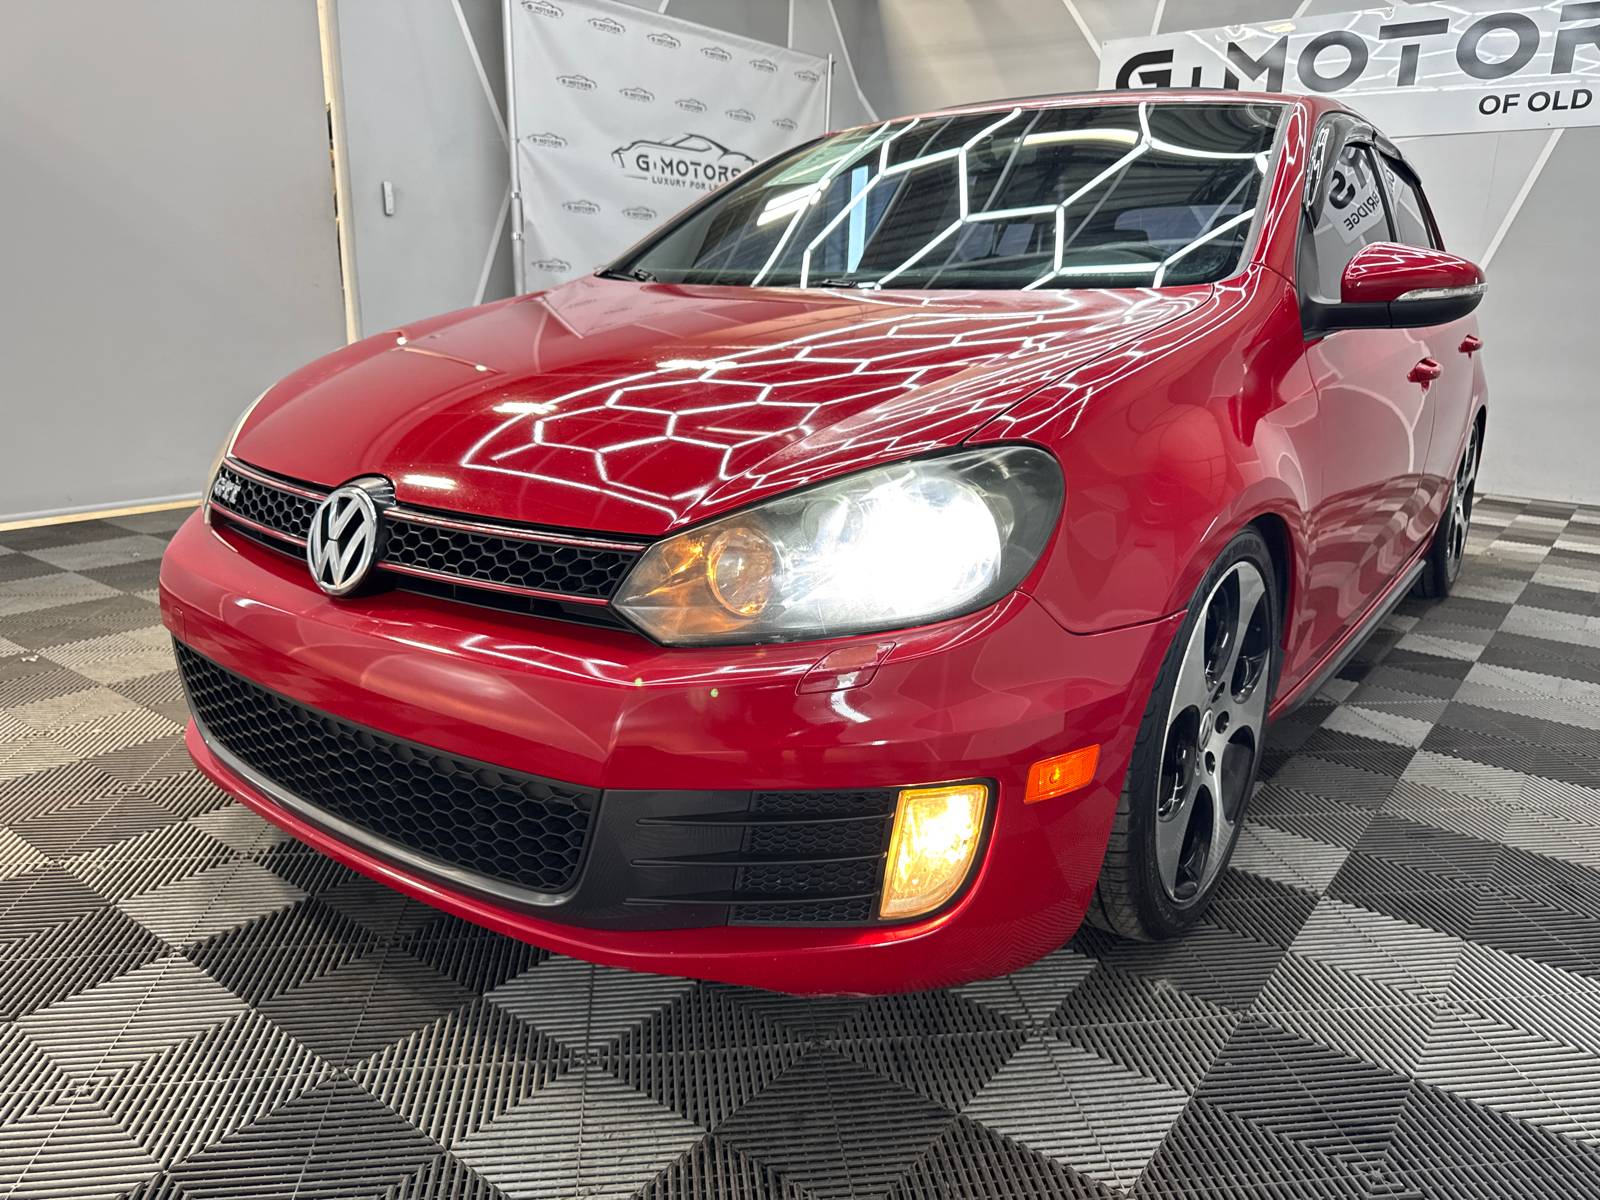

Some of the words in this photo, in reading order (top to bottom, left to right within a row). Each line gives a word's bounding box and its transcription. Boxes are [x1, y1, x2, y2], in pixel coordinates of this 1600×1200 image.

[1478, 93, 1521, 115] OF
[1527, 89, 1593, 112] OLD
[651, 176, 686, 188] LUXURY
[689, 181, 706, 190] FOR
